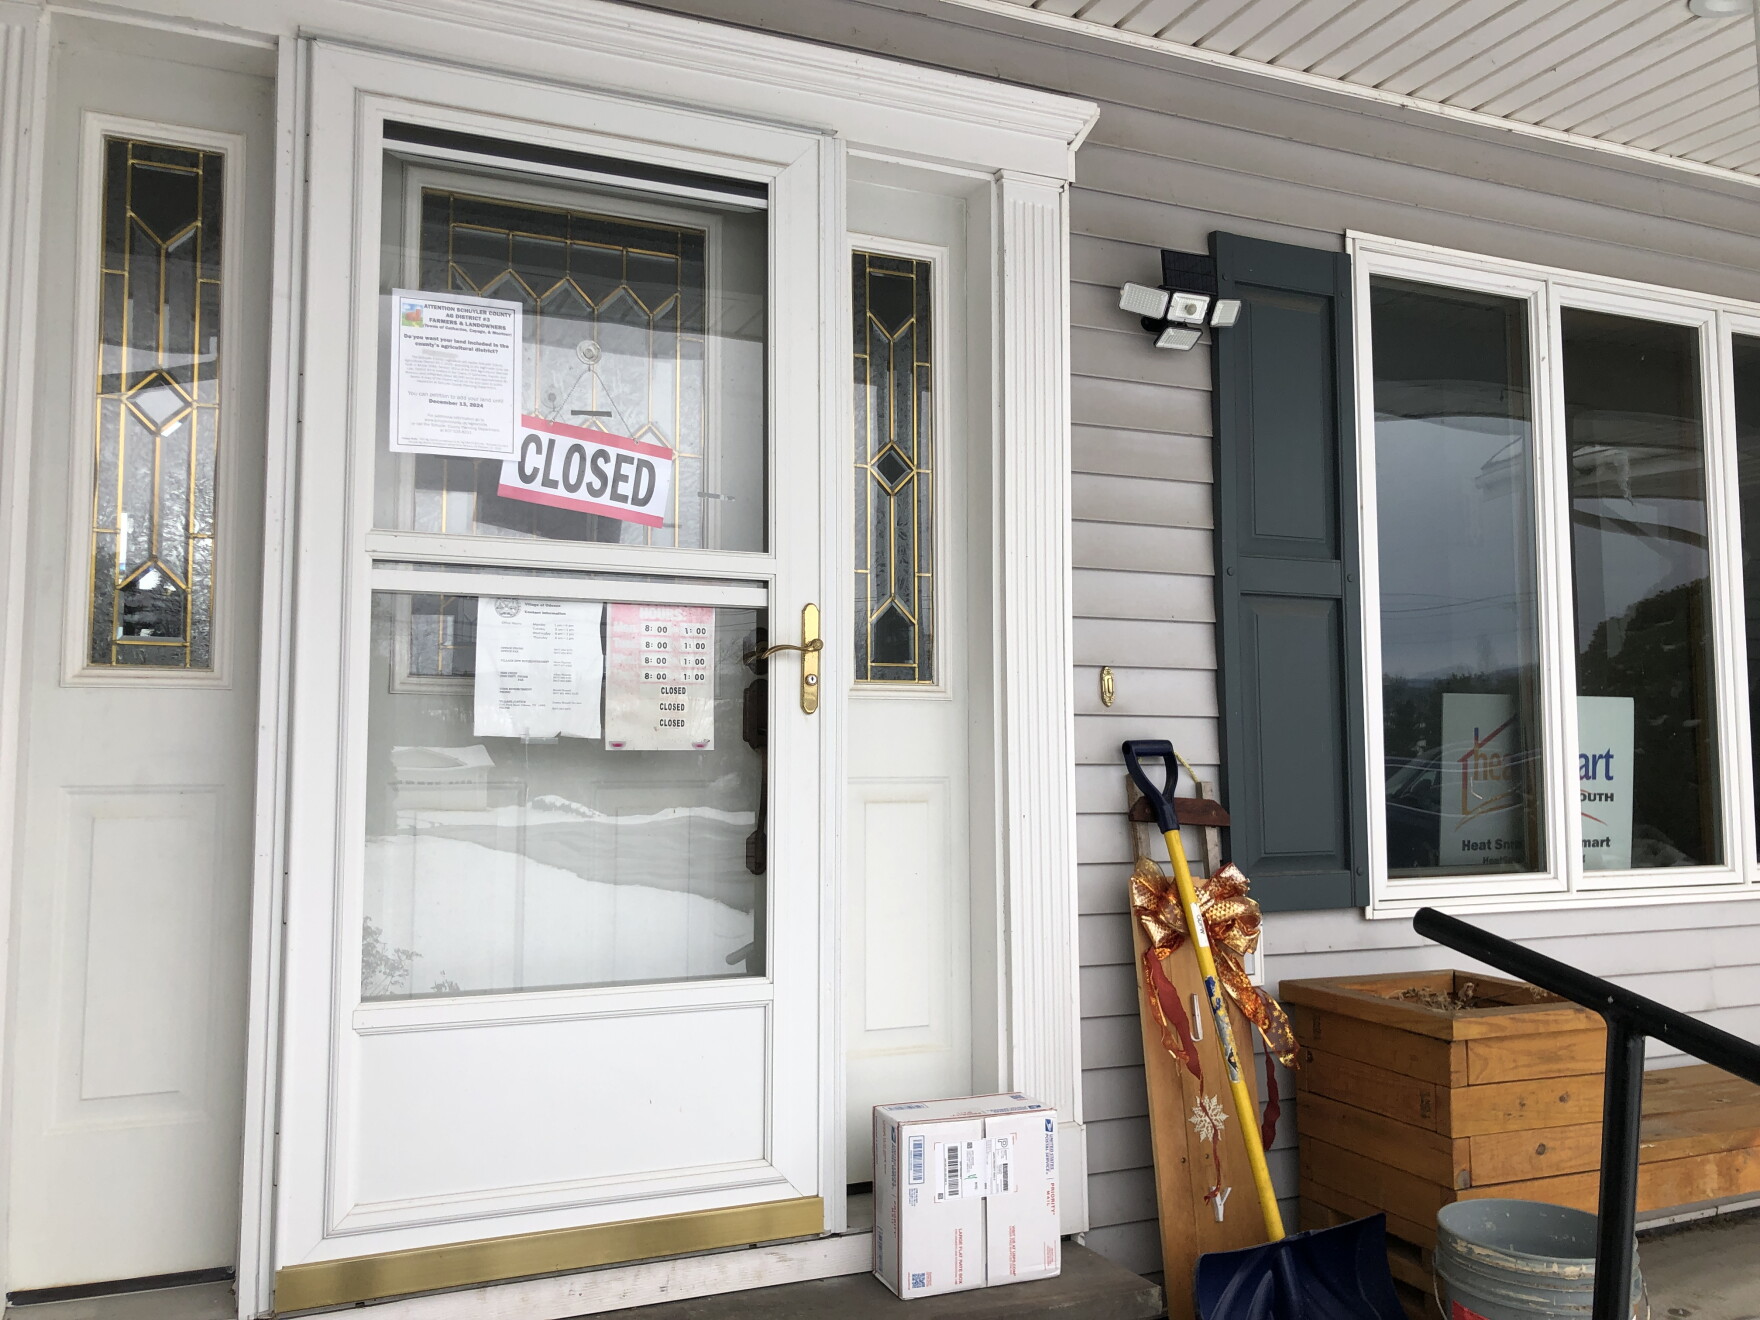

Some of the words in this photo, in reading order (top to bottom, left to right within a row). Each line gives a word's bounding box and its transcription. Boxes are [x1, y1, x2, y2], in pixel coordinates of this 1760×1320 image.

[424, 304, 455, 312] ATTENTION
[457, 307, 487, 315] SCHUYLER
[489, 310, 512, 318] COUNTY
[465, 322, 506, 330] LANDOWNERS
[441, 344, 474, 352] agricultural
[517, 434, 656, 507] CLOSED
[660, 703, 685, 711] CLOSED
[660, 718, 685, 727] CLOSED
[1579, 747, 1614, 780] art
[1580, 793, 1614, 802] OUTH
[1462, 839, 1492, 851] Heat
[1582, 837, 1611, 847] mart
[998, 1138, 1008, 1148] P
